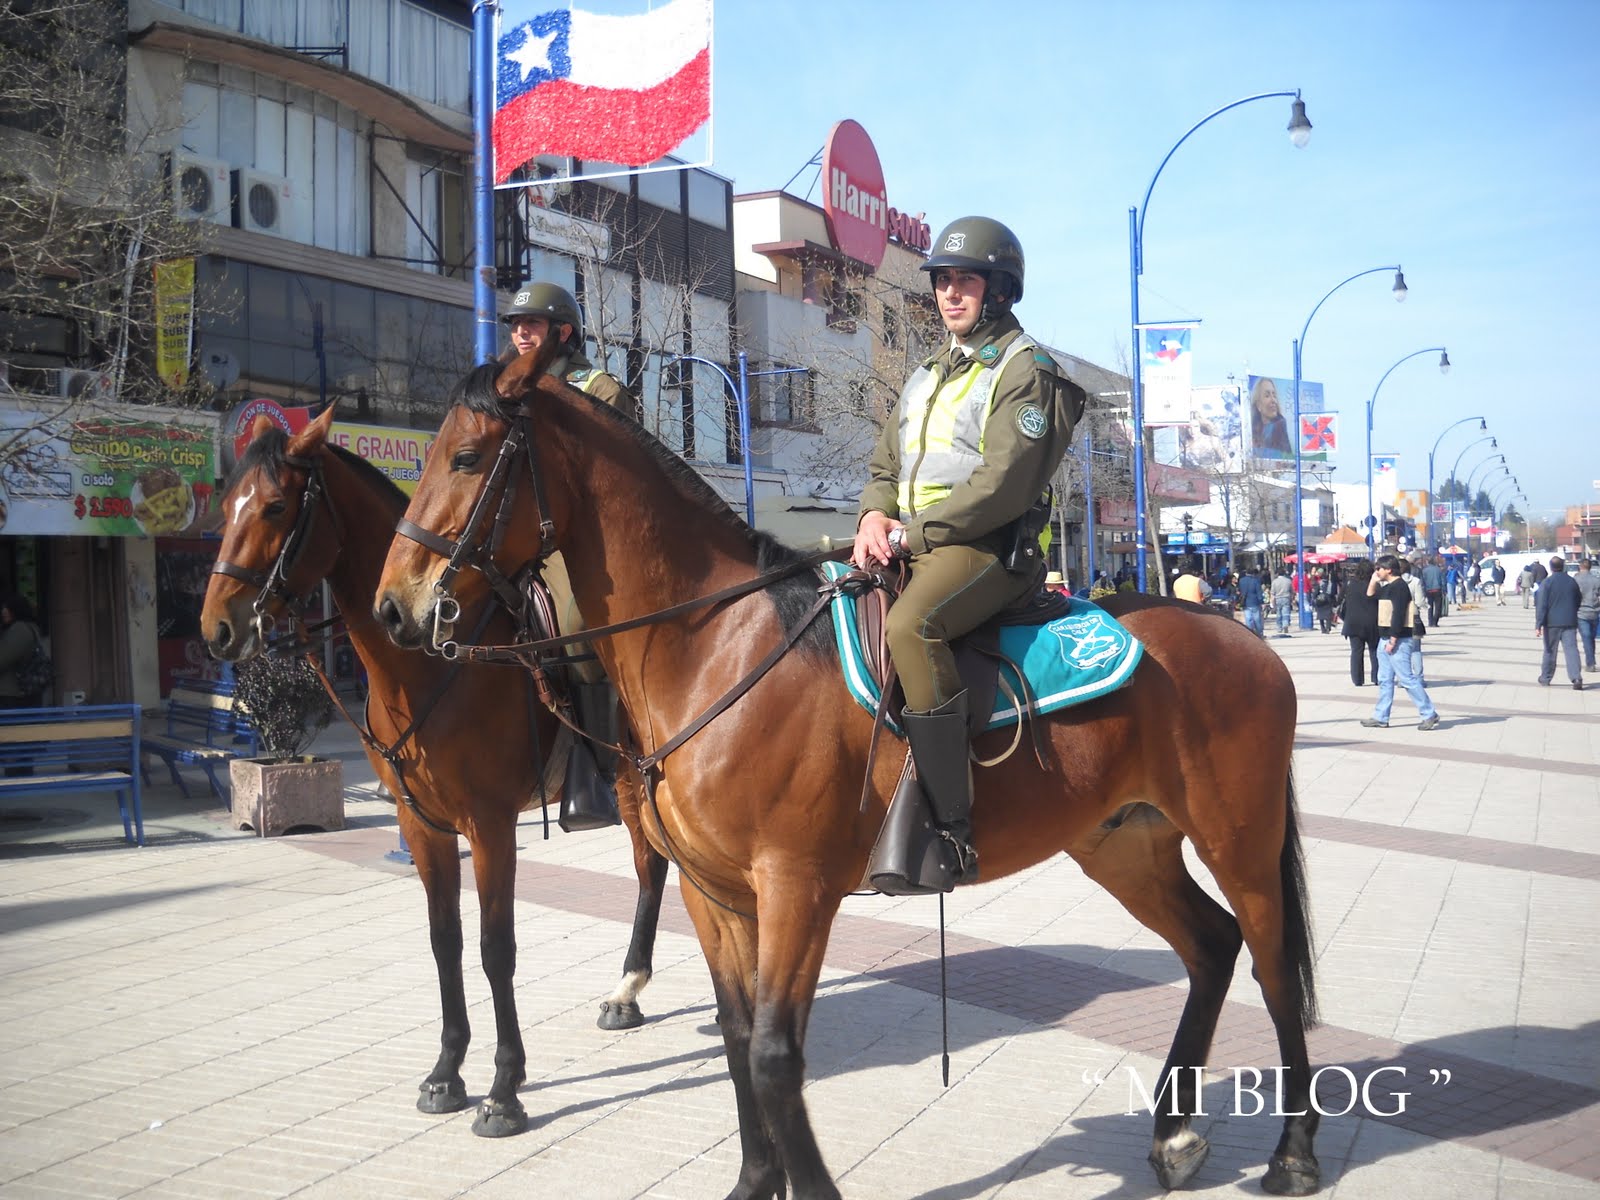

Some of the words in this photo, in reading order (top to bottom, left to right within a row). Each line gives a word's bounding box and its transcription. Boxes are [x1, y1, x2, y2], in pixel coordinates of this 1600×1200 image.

[256, 403, 266, 413] DE
[356, 435, 419, 462] GRAND
[93, 472, 115, 487] solo
[74, 494, 87, 520] $
